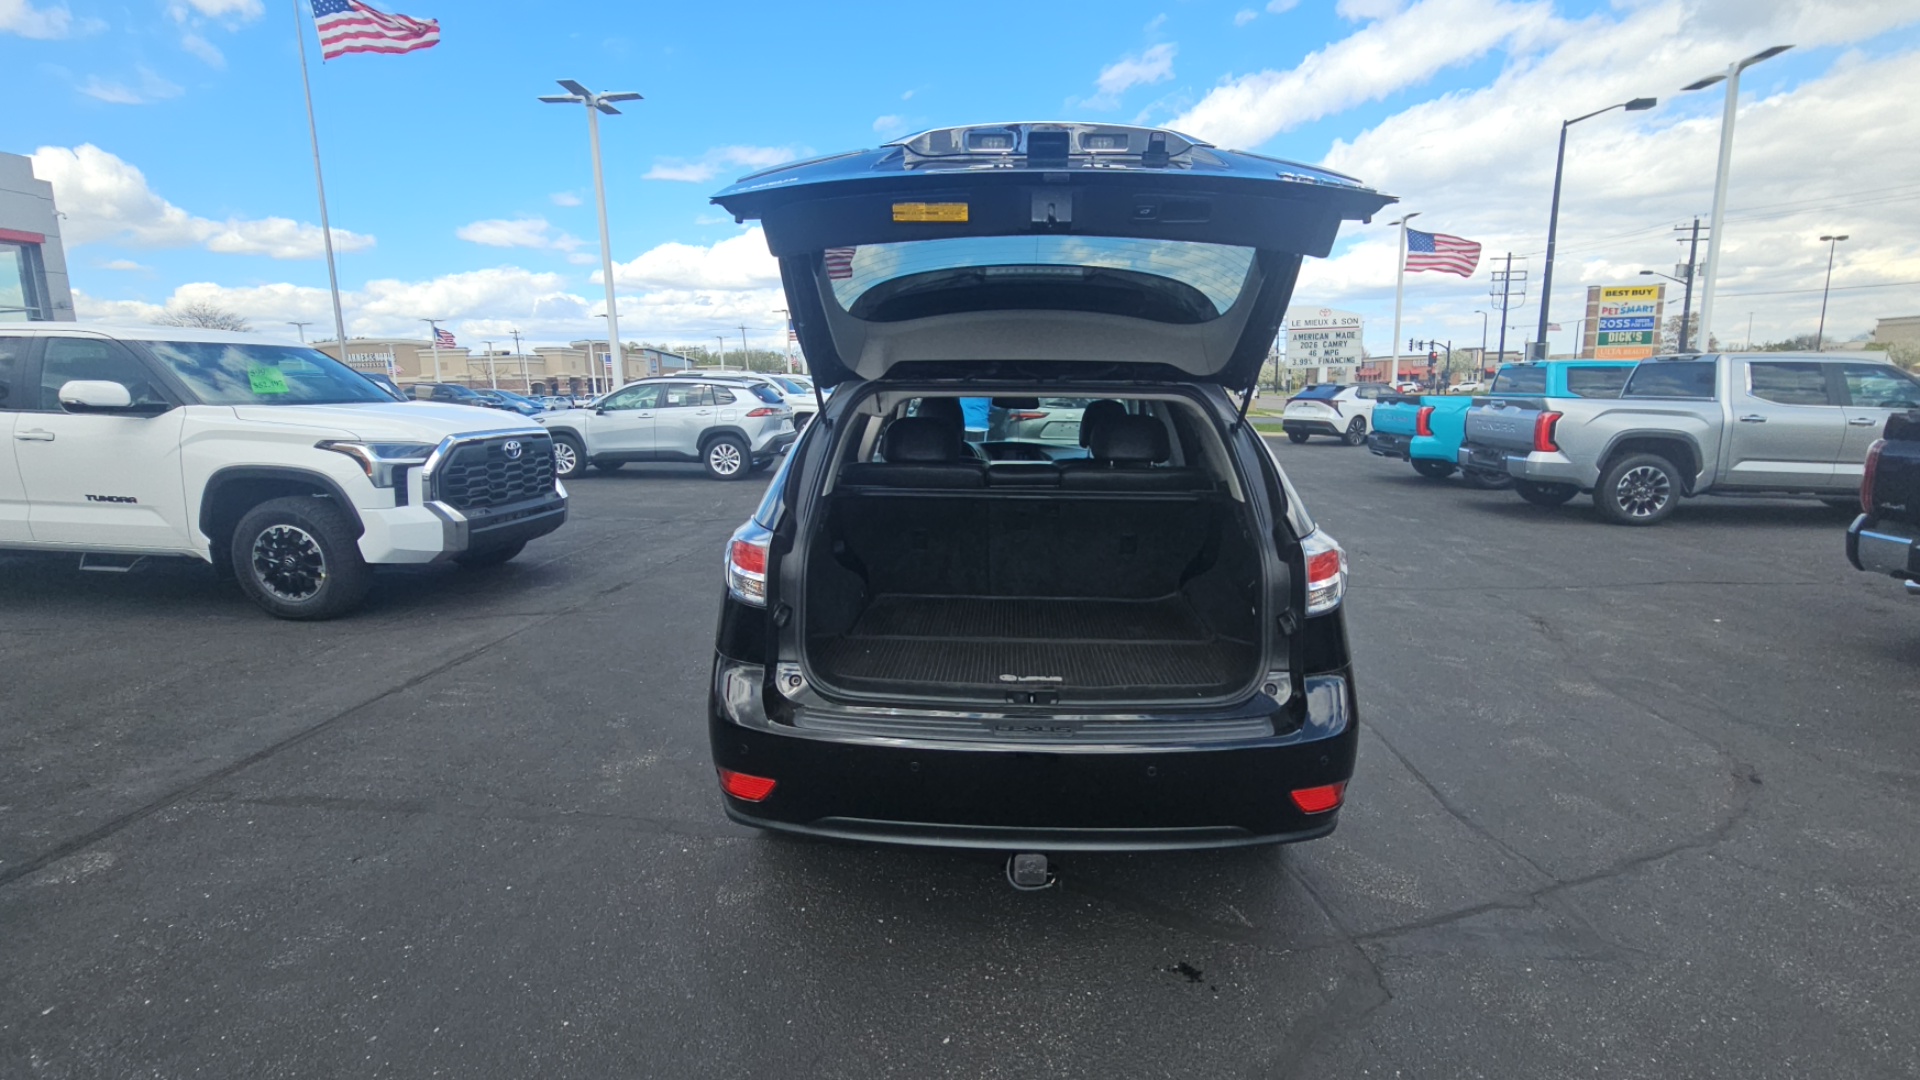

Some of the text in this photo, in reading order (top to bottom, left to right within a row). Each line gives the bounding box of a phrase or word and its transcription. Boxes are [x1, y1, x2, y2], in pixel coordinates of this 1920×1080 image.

[1605, 288, 1654, 297] BEST BUY
[1291, 319, 1302, 327] LE
[1304, 318, 1329, 326] MIEUX
[1341, 317, 1359, 325] SON
[1599, 319, 1631, 329] ROSS
[1292, 331, 1356, 341] AMERICAN MADE
[1608, 331, 1643, 343] DICK'S
[1300, 340, 1348, 349] 2026 CAMRY
[1308, 349, 1339, 357] 46 MPG
[1318, 356, 1356, 364] FINANCING
[85, 494, 138, 504] TUNDRA
